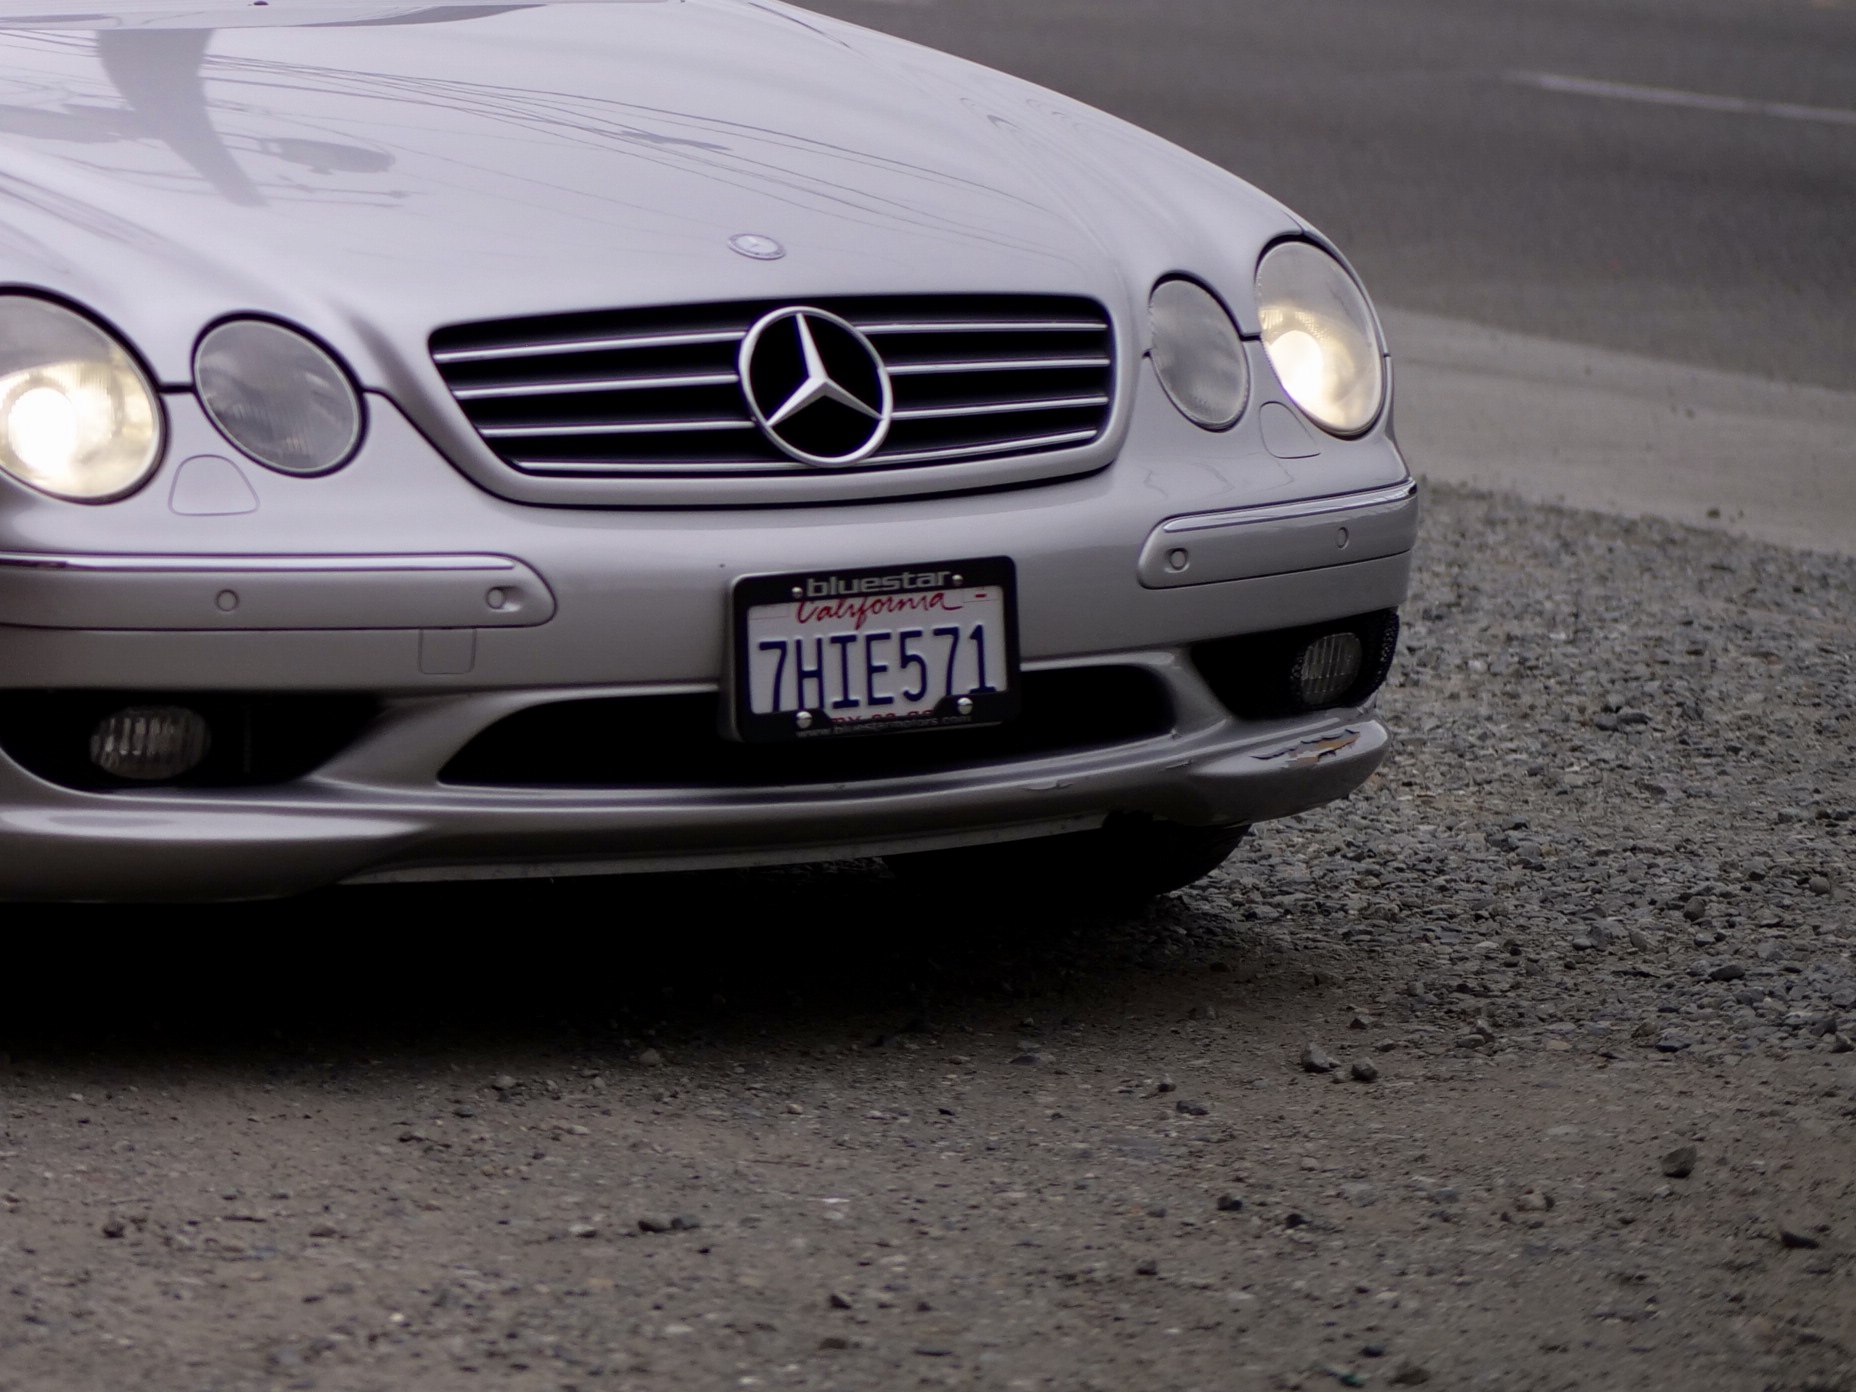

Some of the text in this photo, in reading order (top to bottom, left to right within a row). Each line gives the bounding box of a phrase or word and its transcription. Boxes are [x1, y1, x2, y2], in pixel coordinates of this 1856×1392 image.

[806, 571, 951, 597] bluestar
[797, 593, 963, 630] California
[758, 624, 997, 712] 7HIE571
